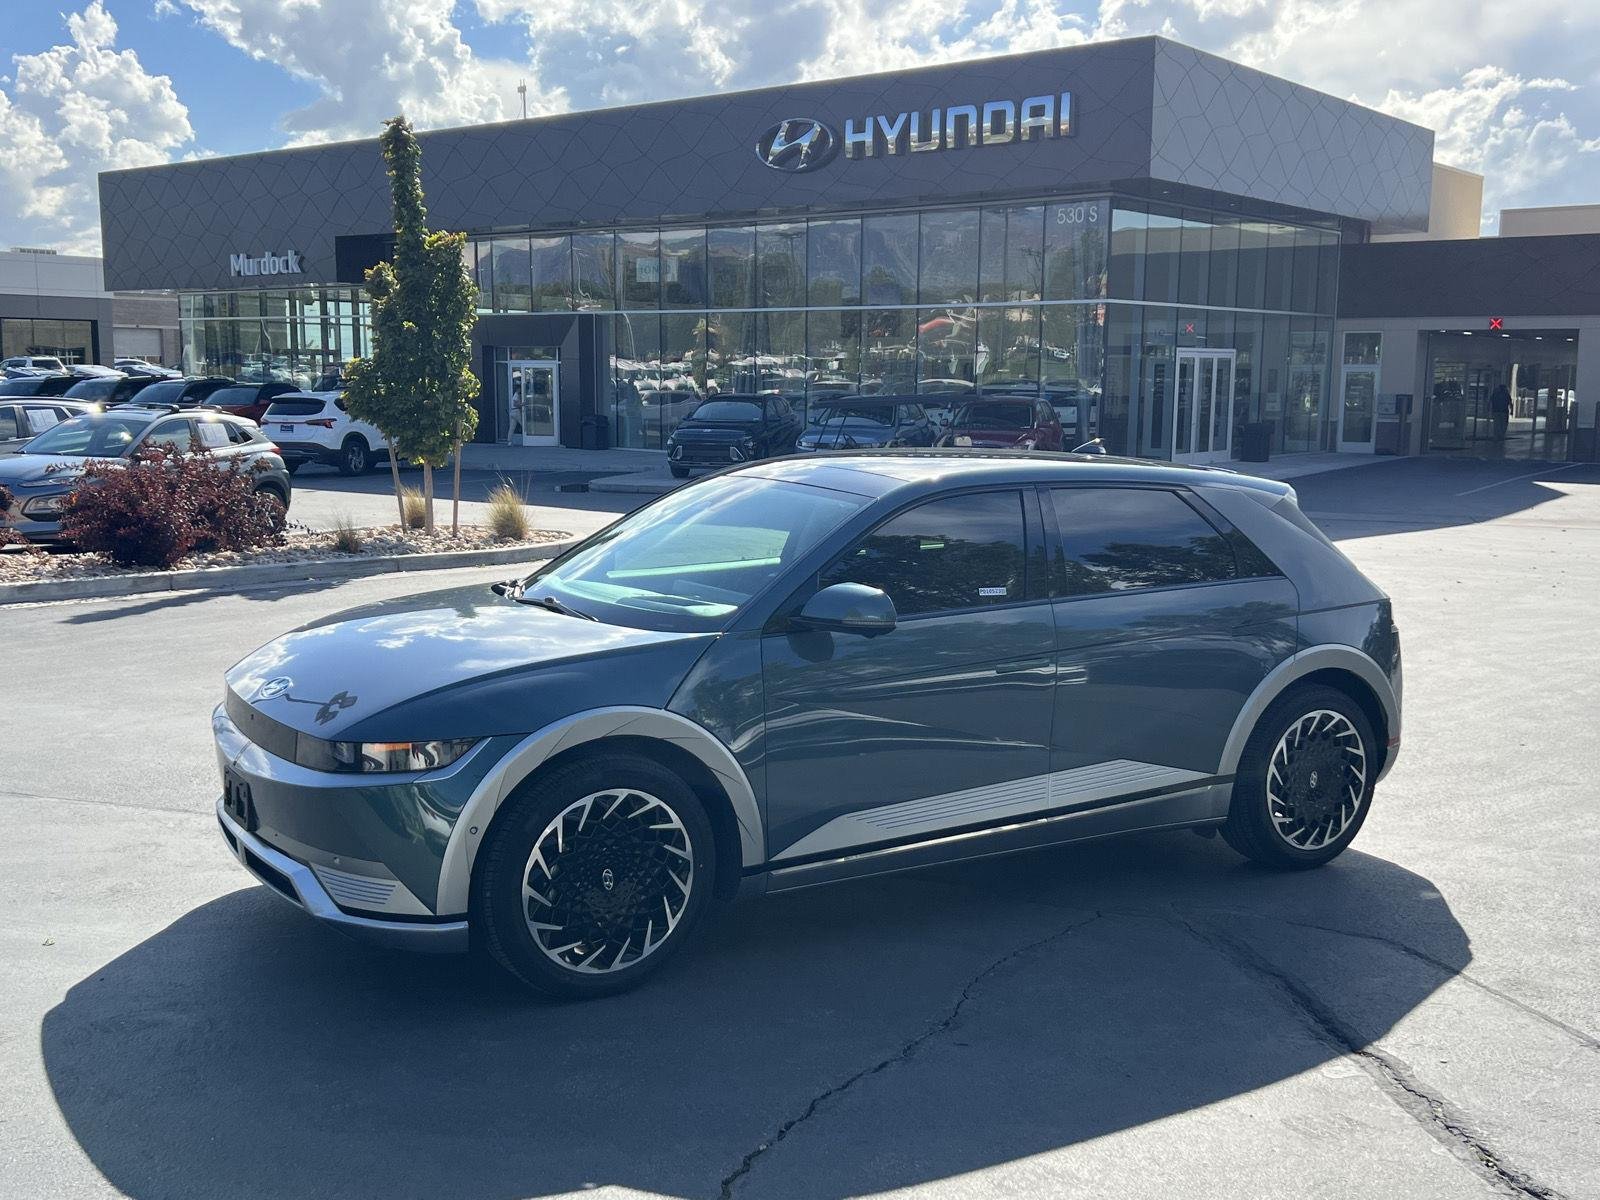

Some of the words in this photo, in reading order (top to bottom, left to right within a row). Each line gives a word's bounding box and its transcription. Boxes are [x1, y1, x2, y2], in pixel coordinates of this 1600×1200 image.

[844, 91, 1072, 159] HYUNDAI
[1057, 206, 1084, 225] 530
[1089, 206, 1098, 223] S
[229, 249, 302, 277] Murdock
